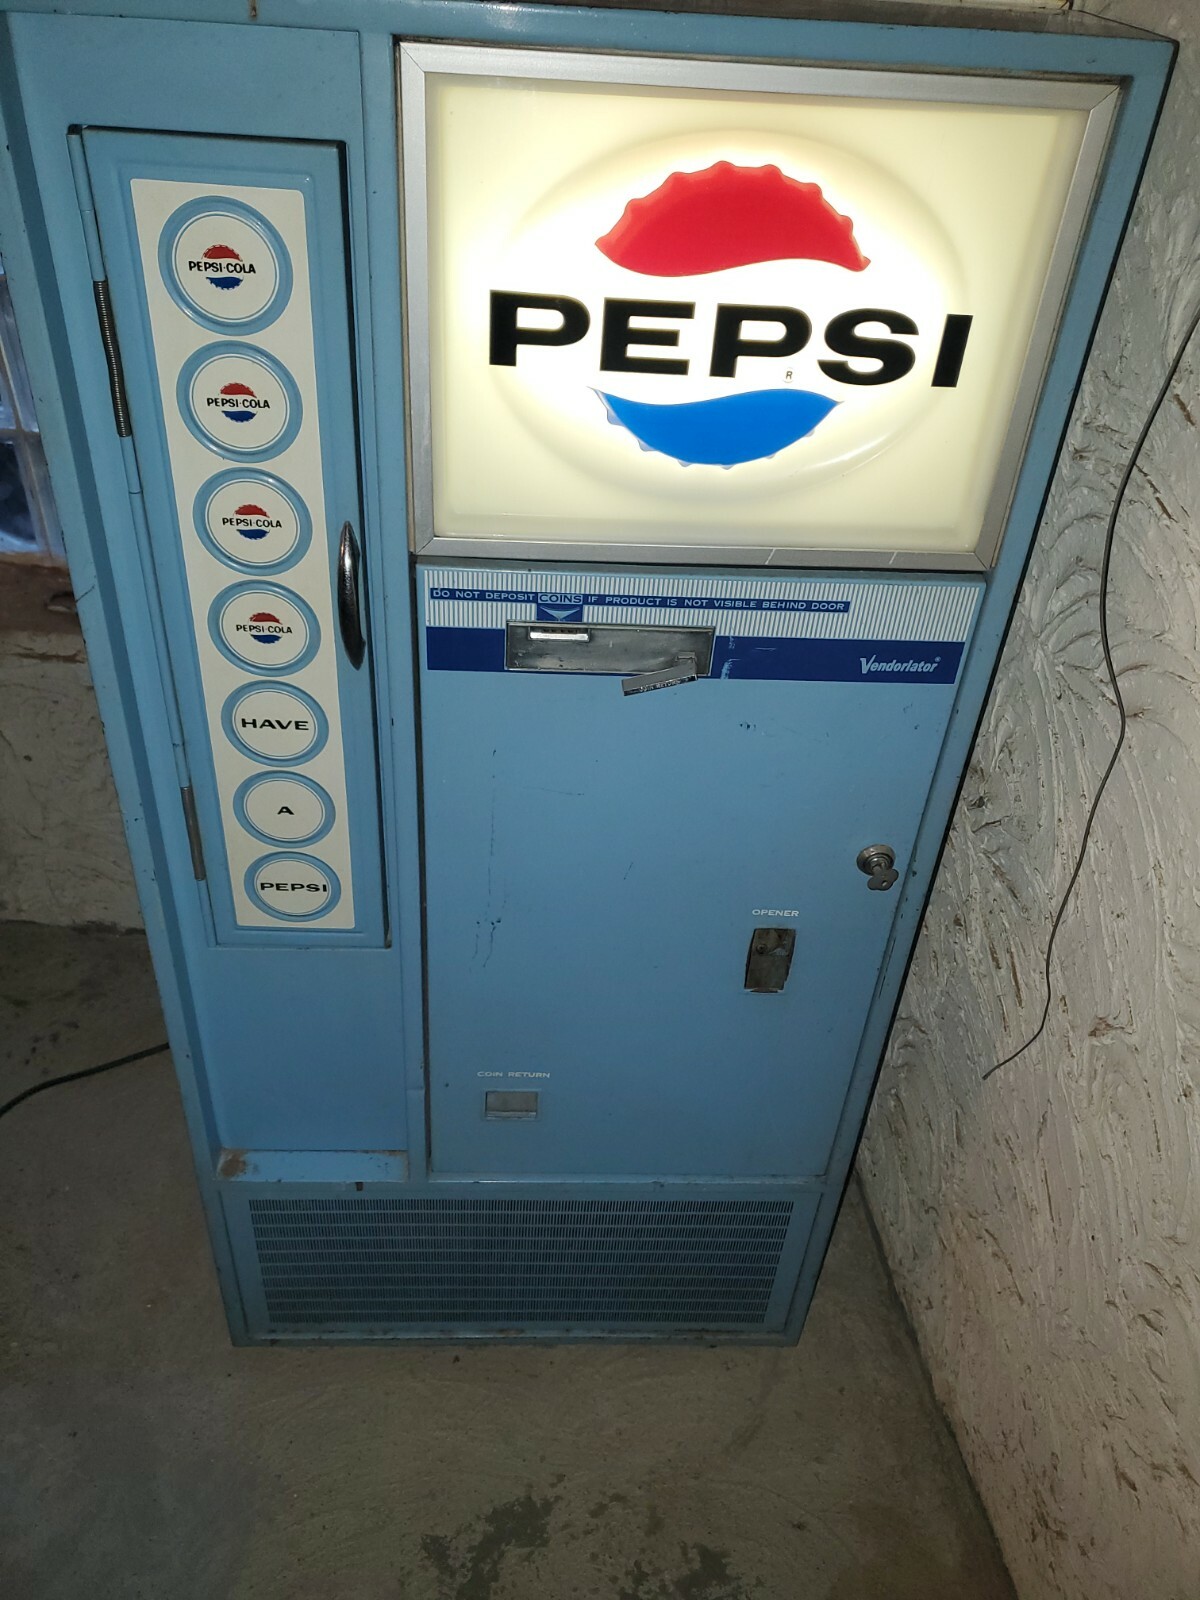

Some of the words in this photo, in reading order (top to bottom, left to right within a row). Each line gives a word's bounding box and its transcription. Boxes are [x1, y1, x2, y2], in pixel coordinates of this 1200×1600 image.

[489, 288, 974, 389] PEPSI
[433, 589, 450, 598] DO
[455, 590, 480, 599] NOT
[485, 592, 536, 601] DEPOSIT
[539, 593, 582, 604] COINS
[588, 595, 599, 603] IF
[605, 596, 661, 606] PRODUCT
[667, 598, 677, 606] IS
[684, 599, 708, 607] NOT
[714, 600, 757, 608] VISIBLE
[762, 601, 806, 609] BEHIND
[811, 602, 845, 611] DOOR
[241, 718, 310, 731] HAVE
[277, 806, 295, 815] A
[259, 882, 328, 893] PEPSI
[751, 908, 800, 917] OPENER
